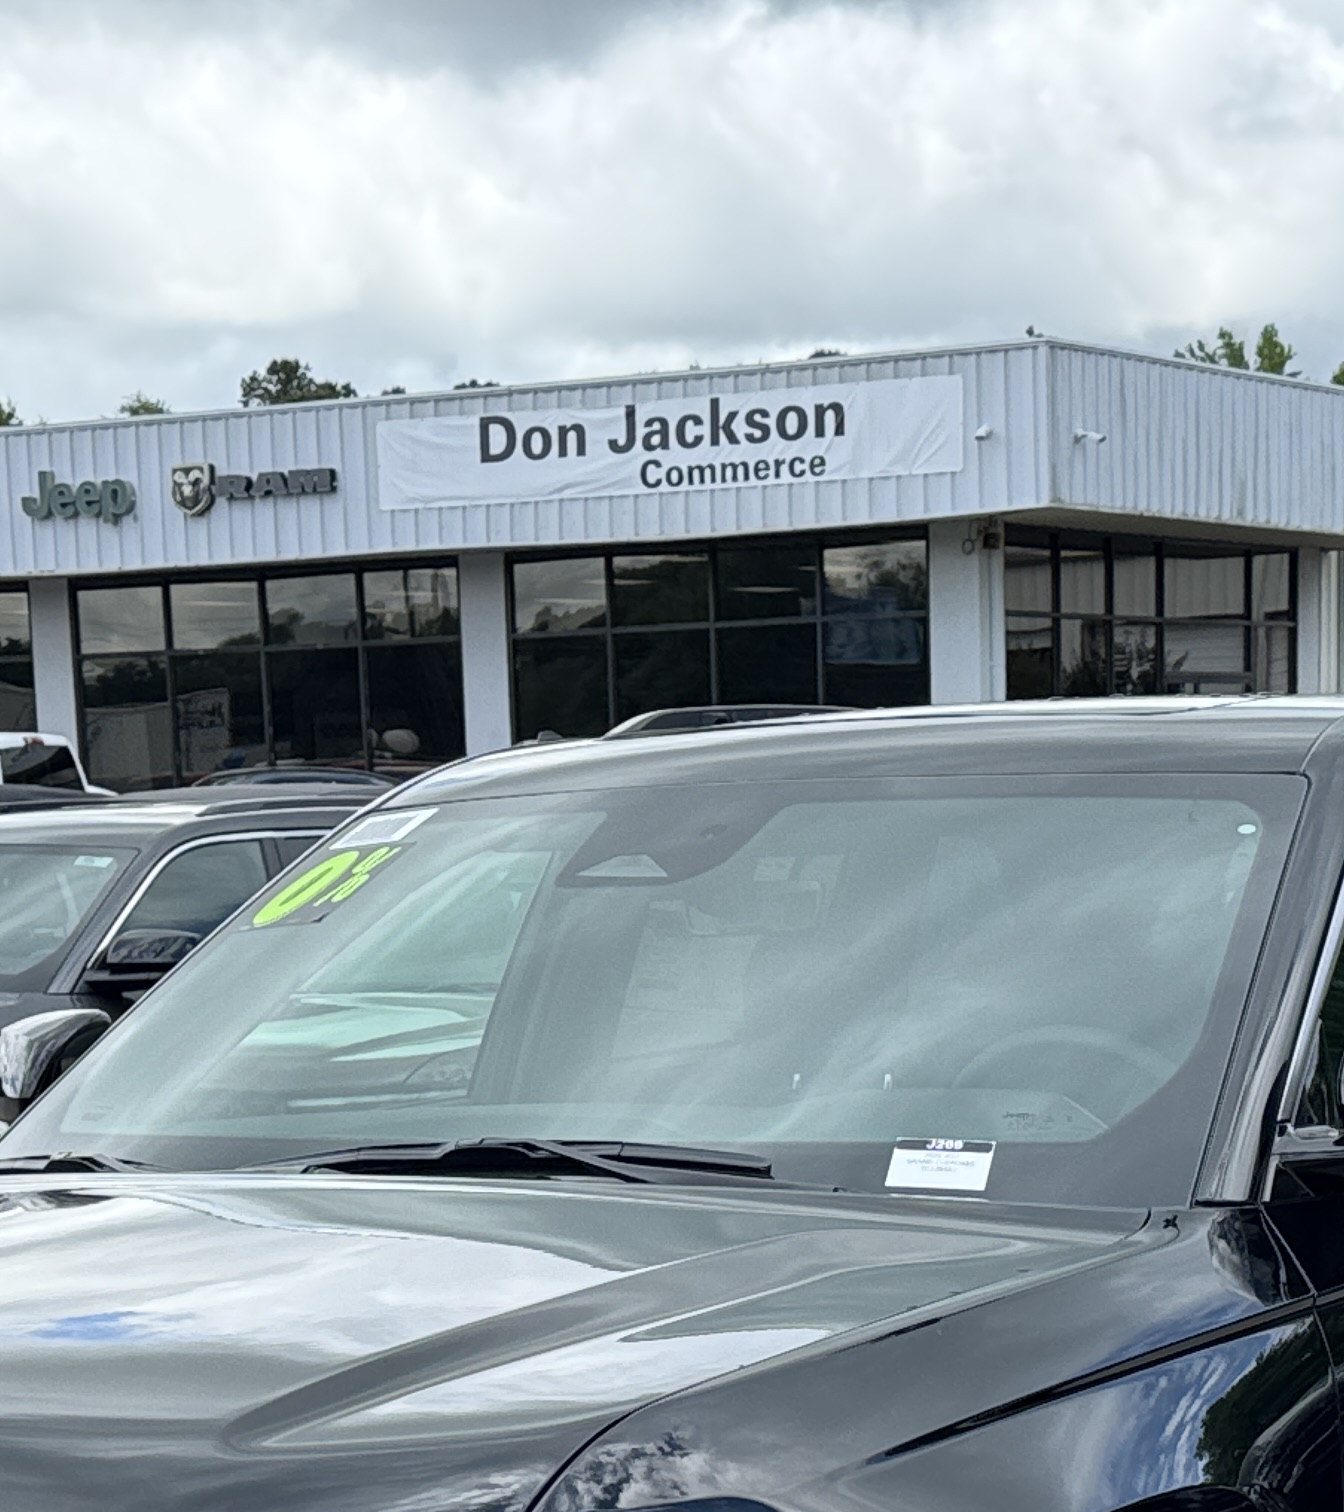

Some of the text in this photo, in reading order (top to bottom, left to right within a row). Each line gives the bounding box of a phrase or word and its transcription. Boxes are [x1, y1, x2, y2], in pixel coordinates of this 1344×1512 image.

[478, 397, 846, 464] Don Jackson
[214, 468, 337, 499] RAM
[639, 454, 828, 489] Commerce
[21, 470, 137, 525] Jeep
